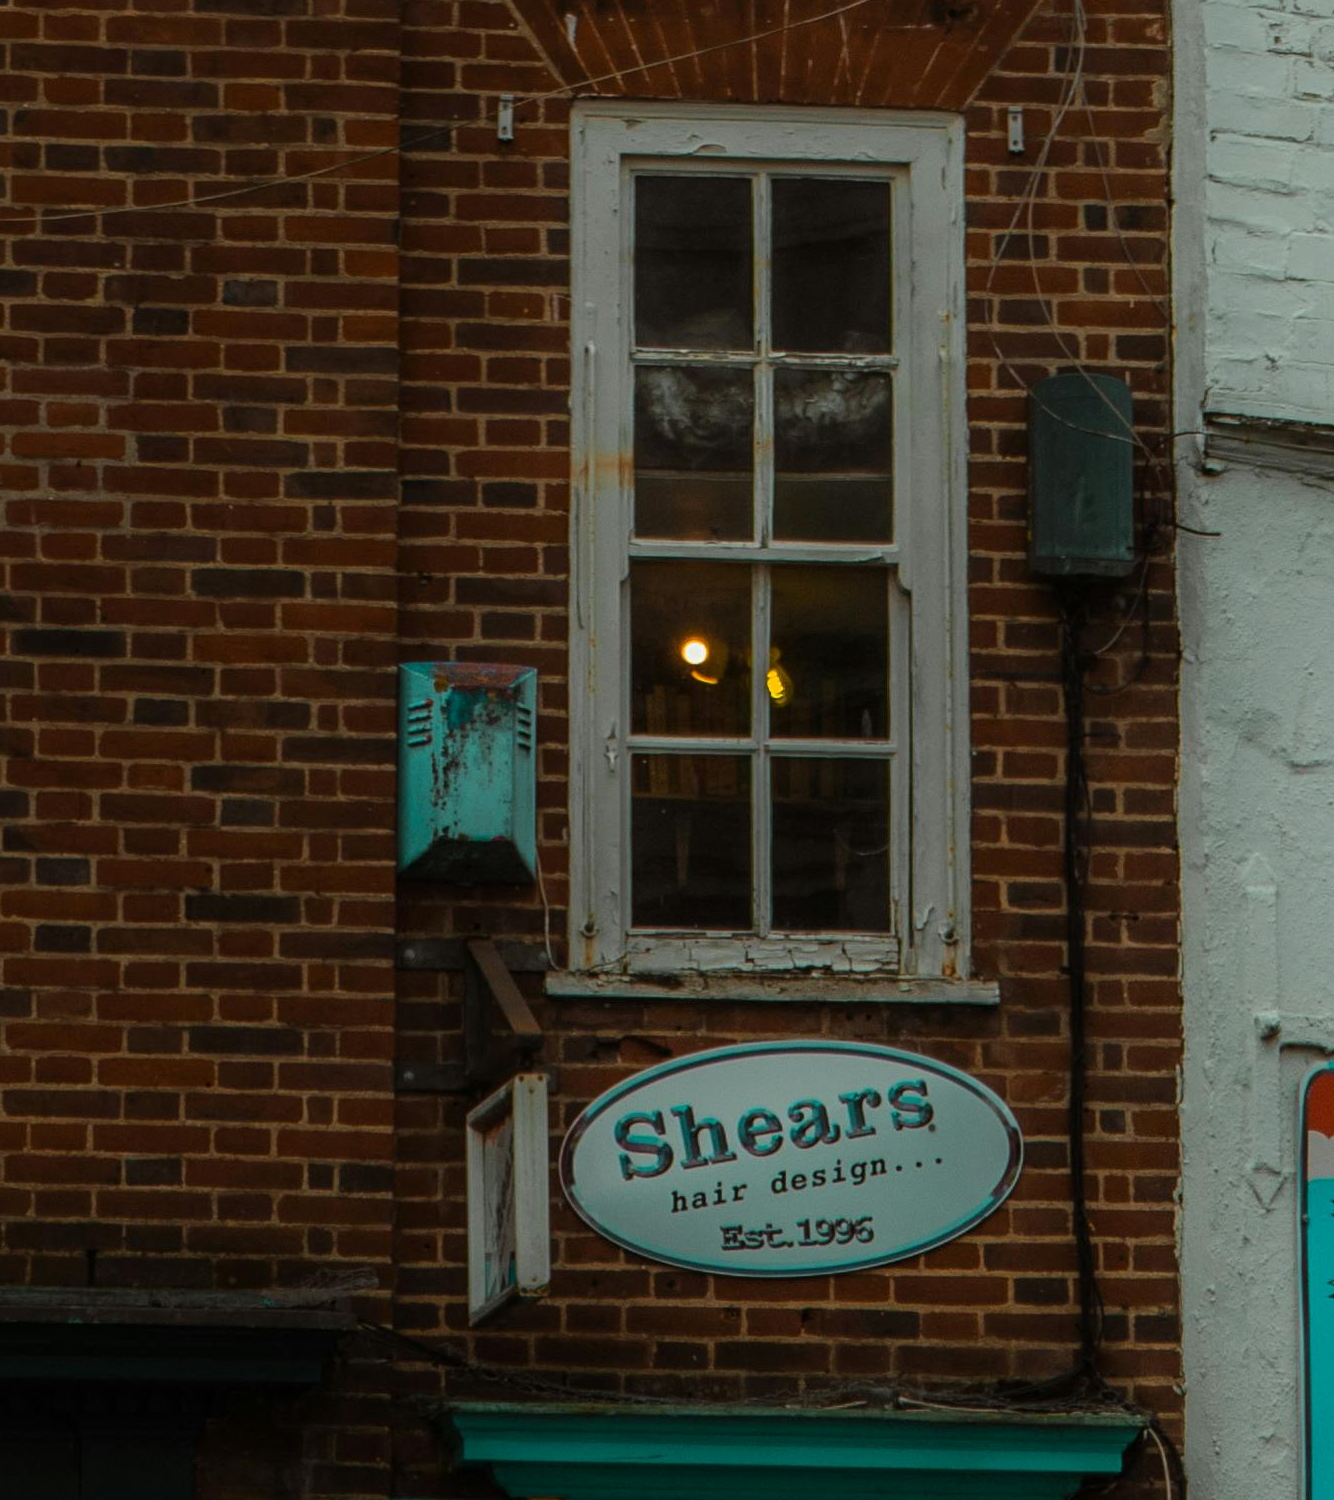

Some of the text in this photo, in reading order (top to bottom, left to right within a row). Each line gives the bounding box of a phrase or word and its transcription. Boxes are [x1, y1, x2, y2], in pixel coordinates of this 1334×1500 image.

[614, 1079, 935, 1181] Shears
[671, 1156, 944, 1213] hair design...
